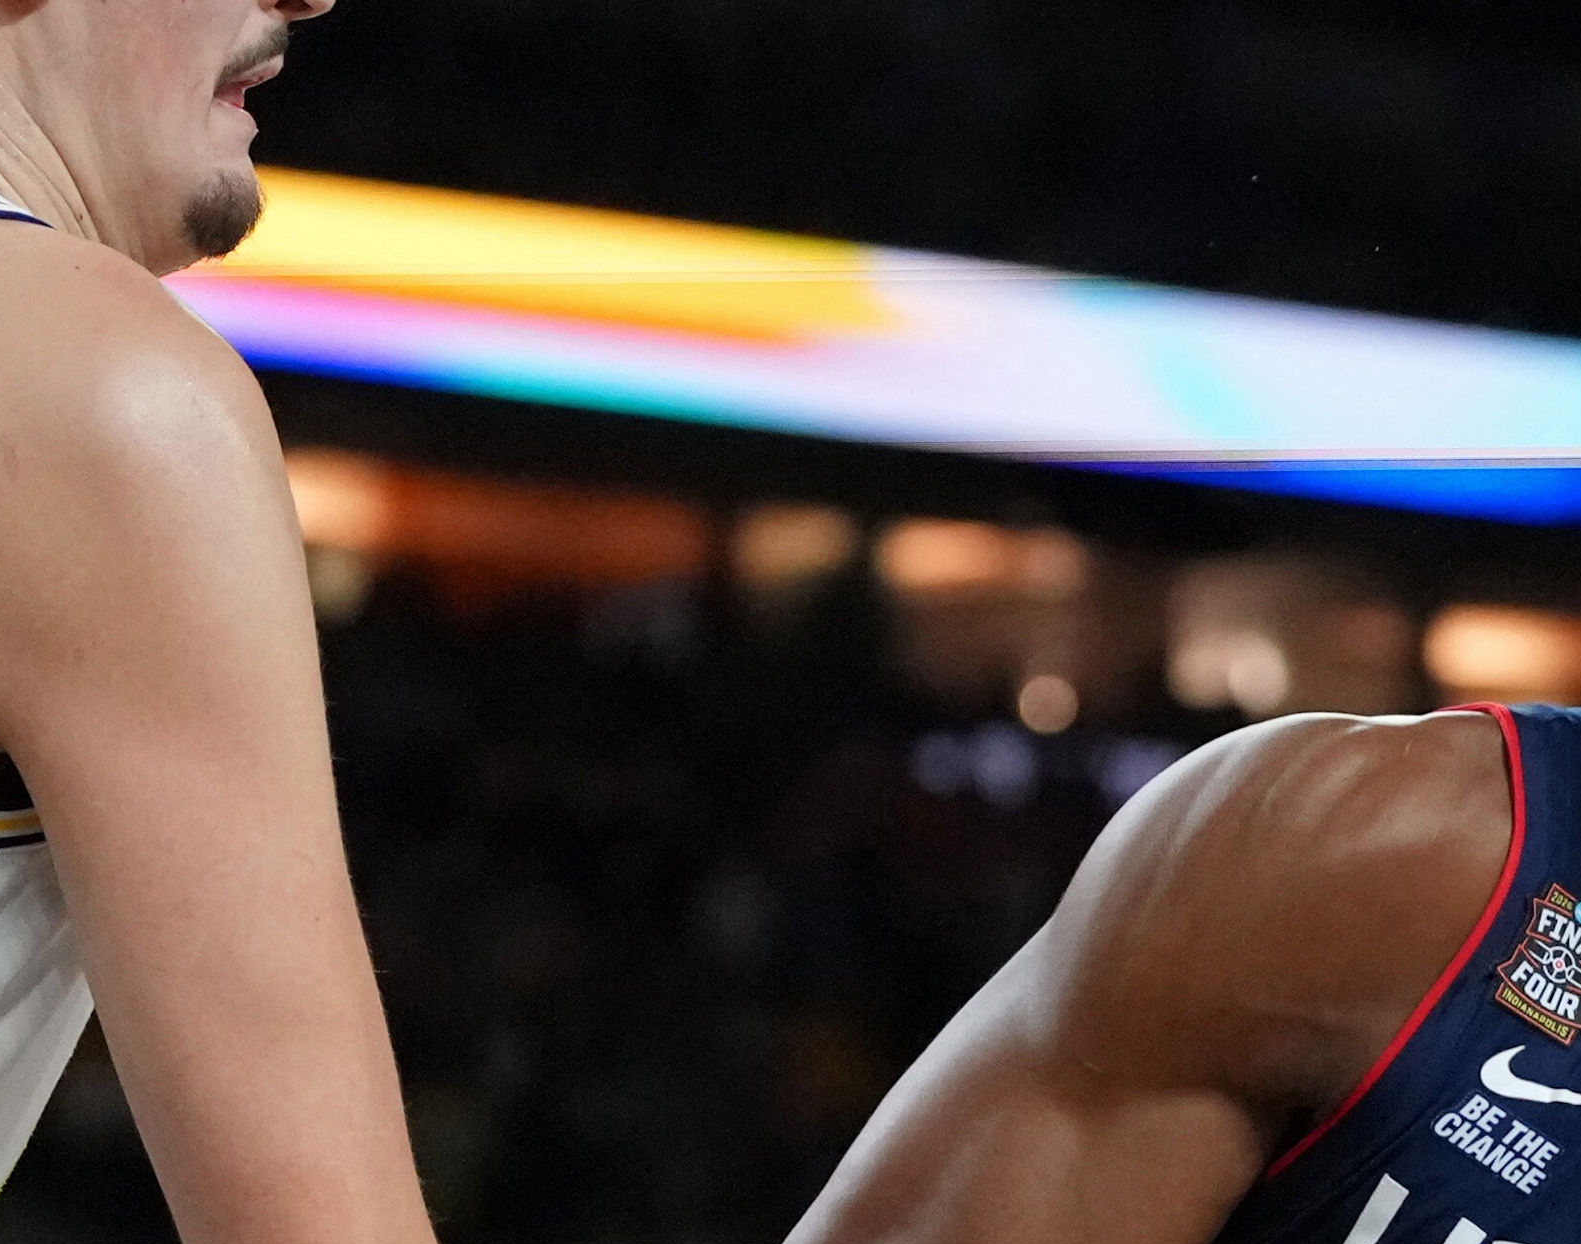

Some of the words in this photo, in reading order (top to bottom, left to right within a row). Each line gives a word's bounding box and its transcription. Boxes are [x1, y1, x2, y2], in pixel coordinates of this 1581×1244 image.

[1502, 987, 1570, 1038] INDIANAPOLIS
[1510, 960, 1579, 1020] FOUR
[1433, 1112, 1547, 1195] CHANGE
[1459, 1094, 1506, 1133] BE
[1503, 1120, 1560, 1169] THE
